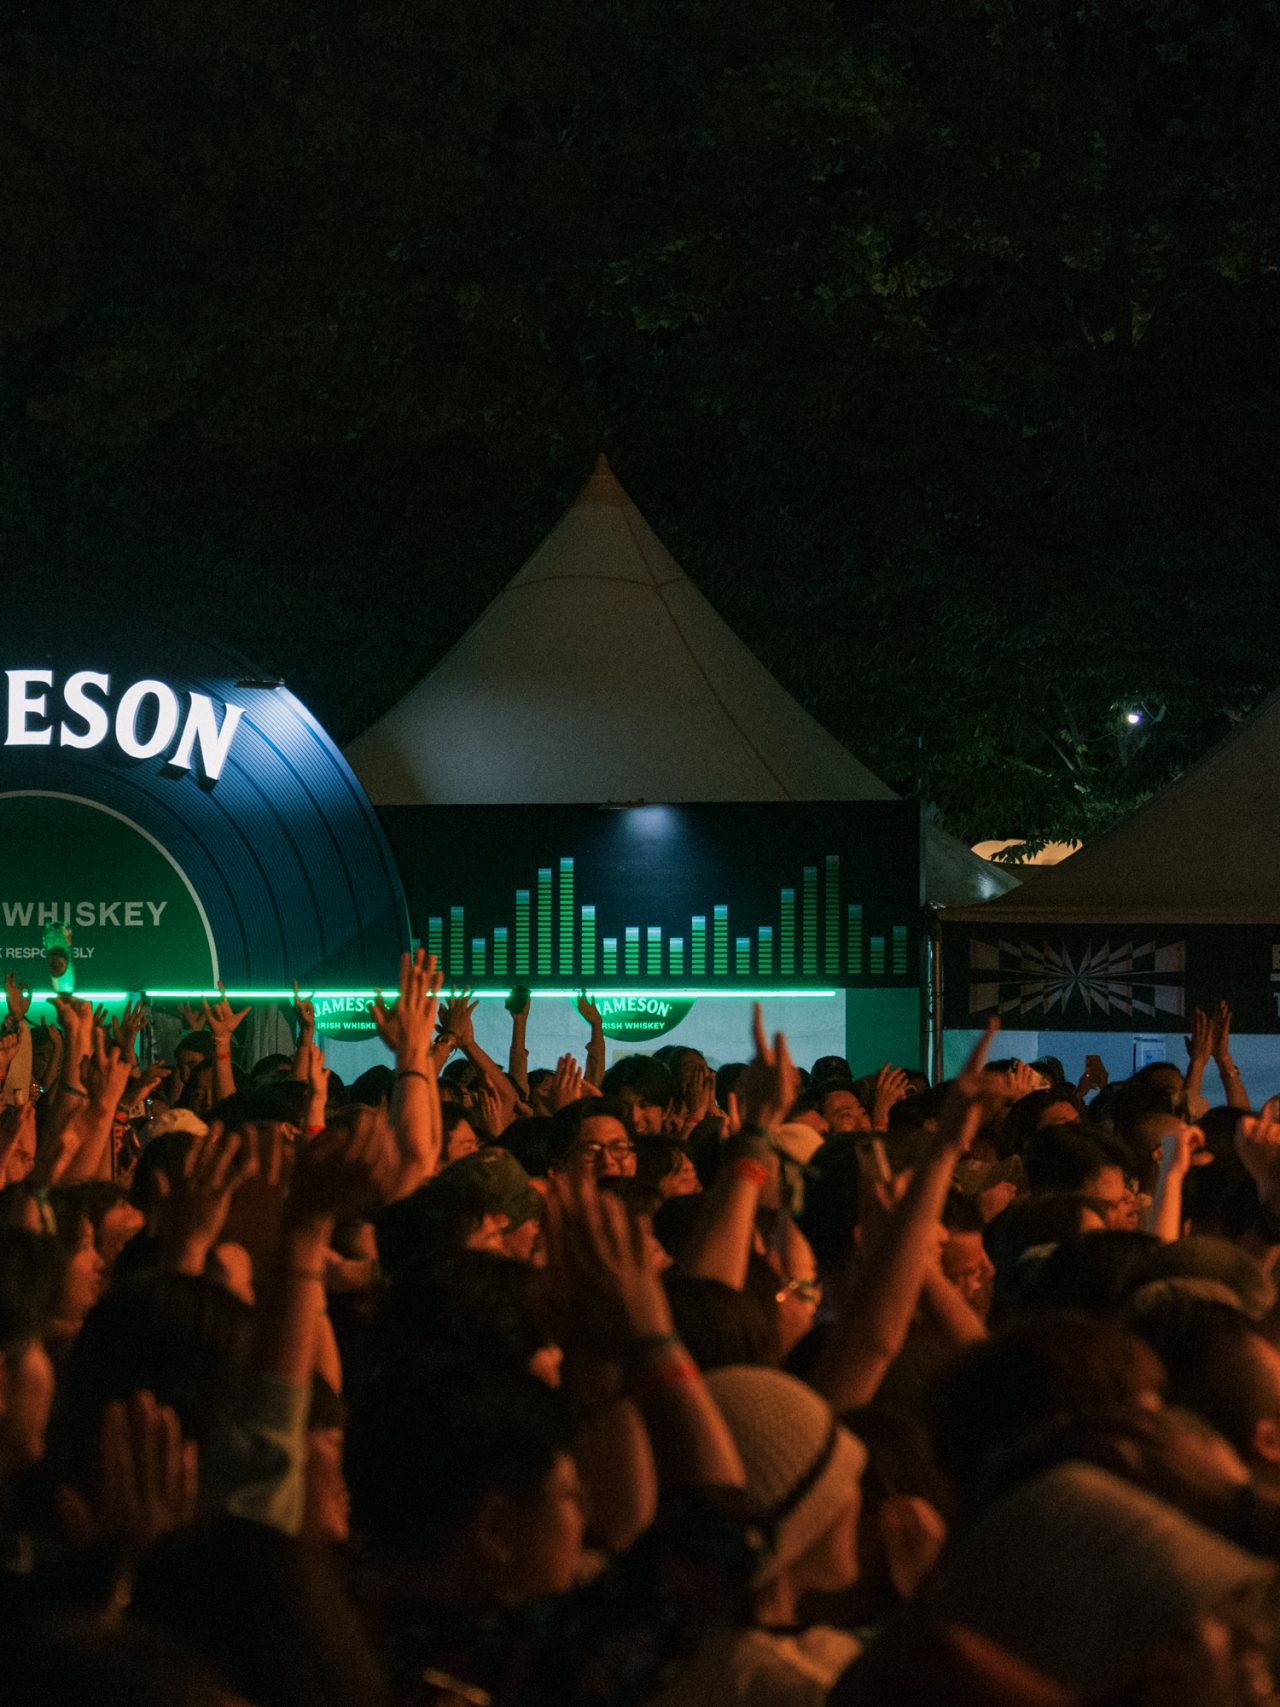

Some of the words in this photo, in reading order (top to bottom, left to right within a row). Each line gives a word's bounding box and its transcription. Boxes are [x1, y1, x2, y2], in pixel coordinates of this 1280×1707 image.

[1, 901, 168, 927] WHISKEY
[317, 1022, 341, 1030] IRISH
[343, 1022, 378, 1030] WHISKE
[624, 1022, 665, 1030] WHISKEY
